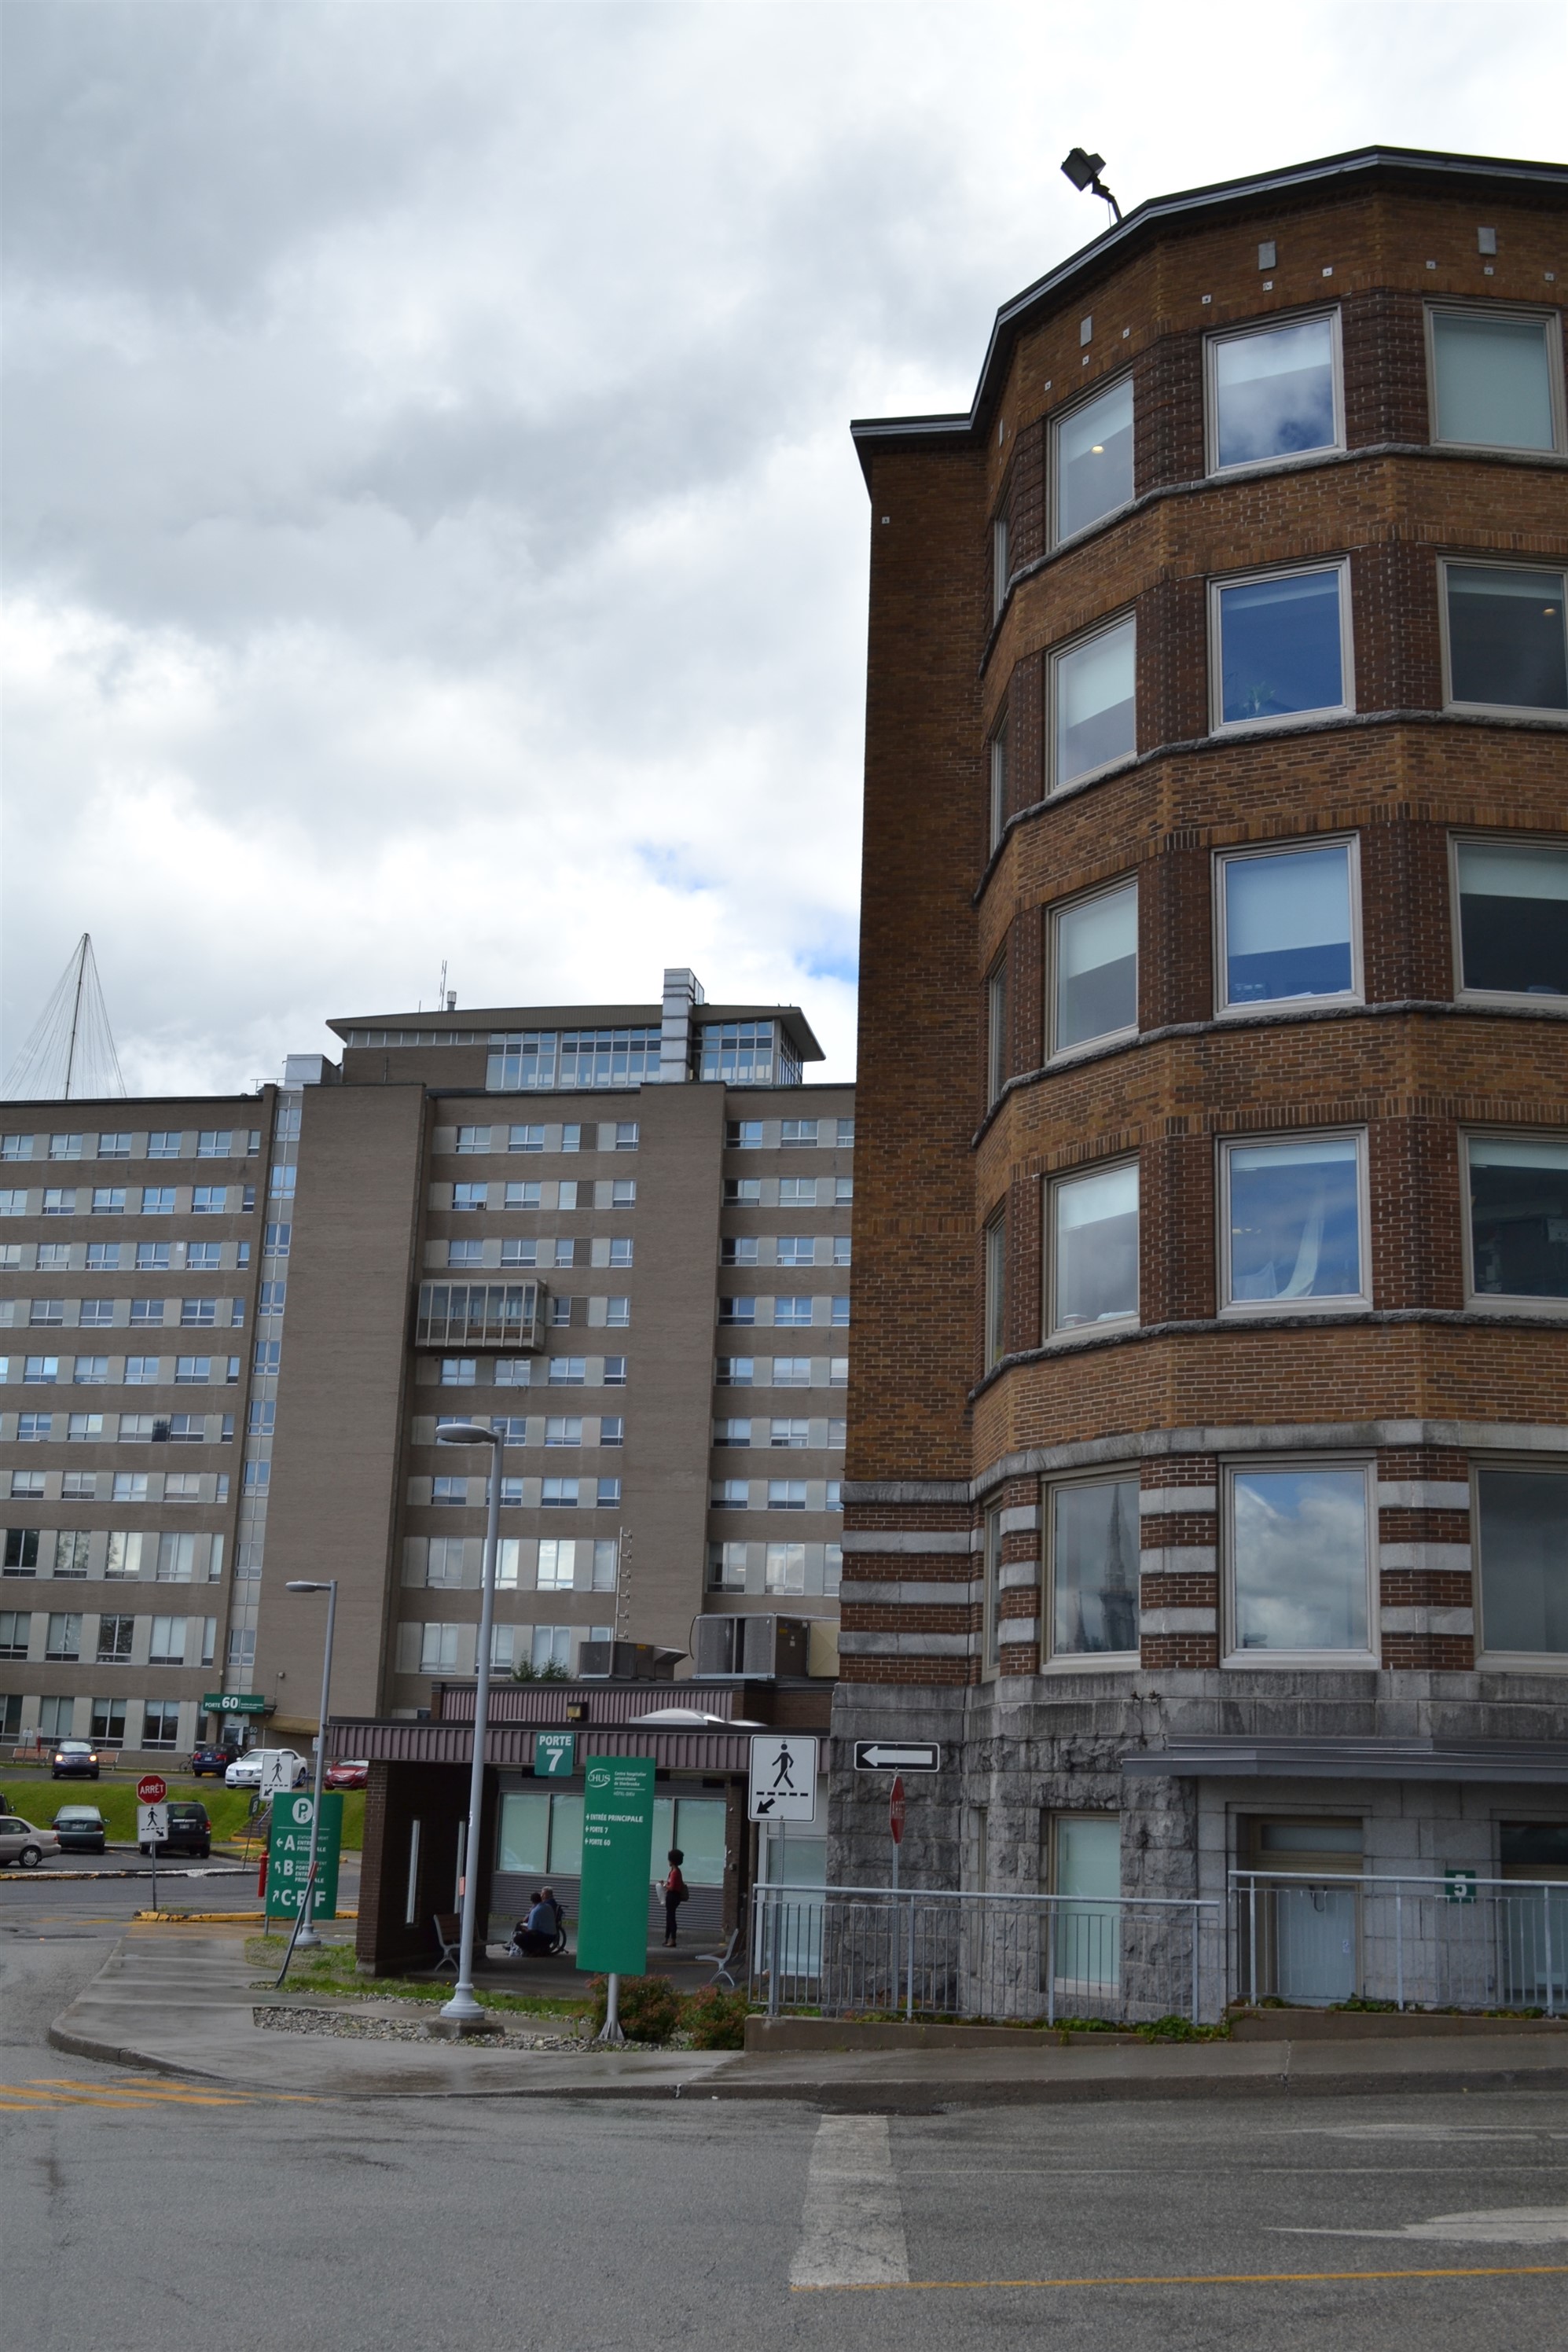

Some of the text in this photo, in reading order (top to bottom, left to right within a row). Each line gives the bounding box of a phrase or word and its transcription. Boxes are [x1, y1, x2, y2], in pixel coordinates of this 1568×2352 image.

[222, 1696, 239, 1709] 60
[539, 1736, 571, 1746] PORTE
[546, 1748, 564, 1772] 7
[587, 1773, 611, 1783] CHUS
[140, 1783, 163, 1795] ARRÊT
[298, 1803, 308, 1818] P
[608, 1814, 644, 1823] PRINCIPALE
[284, 1835, 296, 1850] A
[284, 1860, 294, 1876] B
